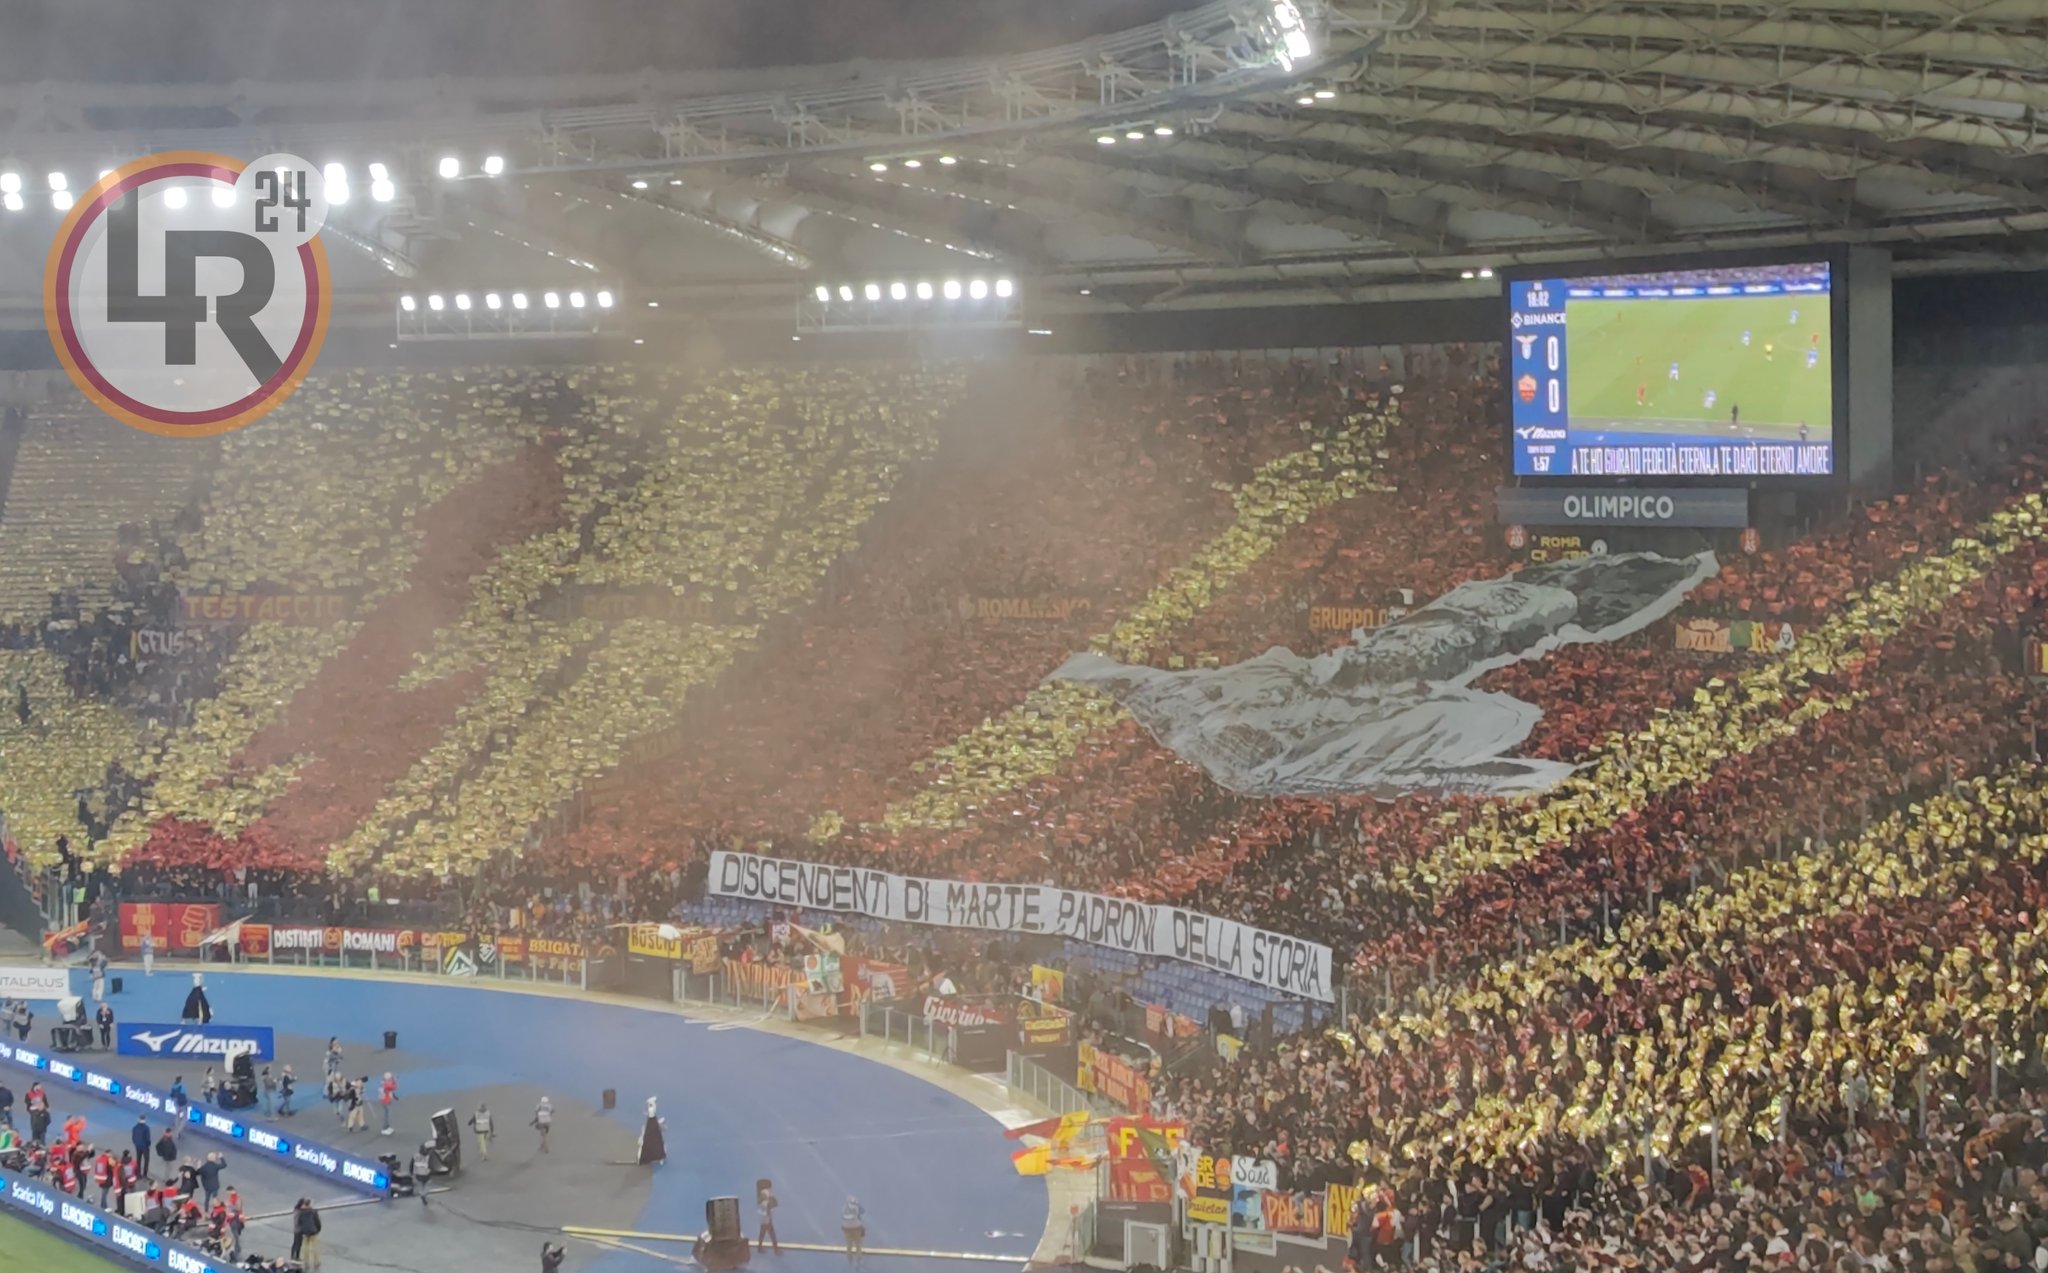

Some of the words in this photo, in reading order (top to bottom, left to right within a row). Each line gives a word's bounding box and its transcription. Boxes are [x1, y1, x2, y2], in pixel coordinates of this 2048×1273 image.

[1523, 313, 1566, 325] BINANCE
[1548, 336, 1559, 371] 0
[1549, 379, 1560, 413] 0
[1572, 448, 1578, 475] A
[1579, 448, 1590, 475] TE
[1590, 448, 1603, 475] HO
[1604, 447, 1640, 475] GIURATO
[1642, 442, 1678, 475] FEDELTÀ
[1720, 447, 1732, 475] TE
[1760, 446, 1795, 475] ETERNO
[1796, 446, 1830, 474] AMORE
[1563, 495, 1674, 519] OLIMPICO
[1540, 536, 1581, 548] ROMA
[1310, 607, 1374, 630] GRUPPO
[720, 854, 890, 917] DISCENDENTI
[904, 879, 930, 922] DI
[1058, 892, 1158, 953] PADRONI
[1173, 910, 1243, 976] DELLA
[1252, 931, 1322, 998] STORIA
[274, 929, 322, 948] DISTINTI
[344, 930, 395, 952] ROMANI
[15, 1048, 39, 1067] EUROBET
[50, 1060, 75, 1079] EUROBET
[87, 1072, 112, 1091] EUROBET
[205, 1113, 234, 1135] EUROBET
[249, 1128, 278, 1150] EUROBET
[295, 1144, 319, 1165] Scarica
[343, 1161, 375, 1184] EUROBET
[12, 1181, 36, 1206] Scarica
[61, 1202, 95, 1231] EUROBET
[113, 1225, 148, 1254] EUROBET
